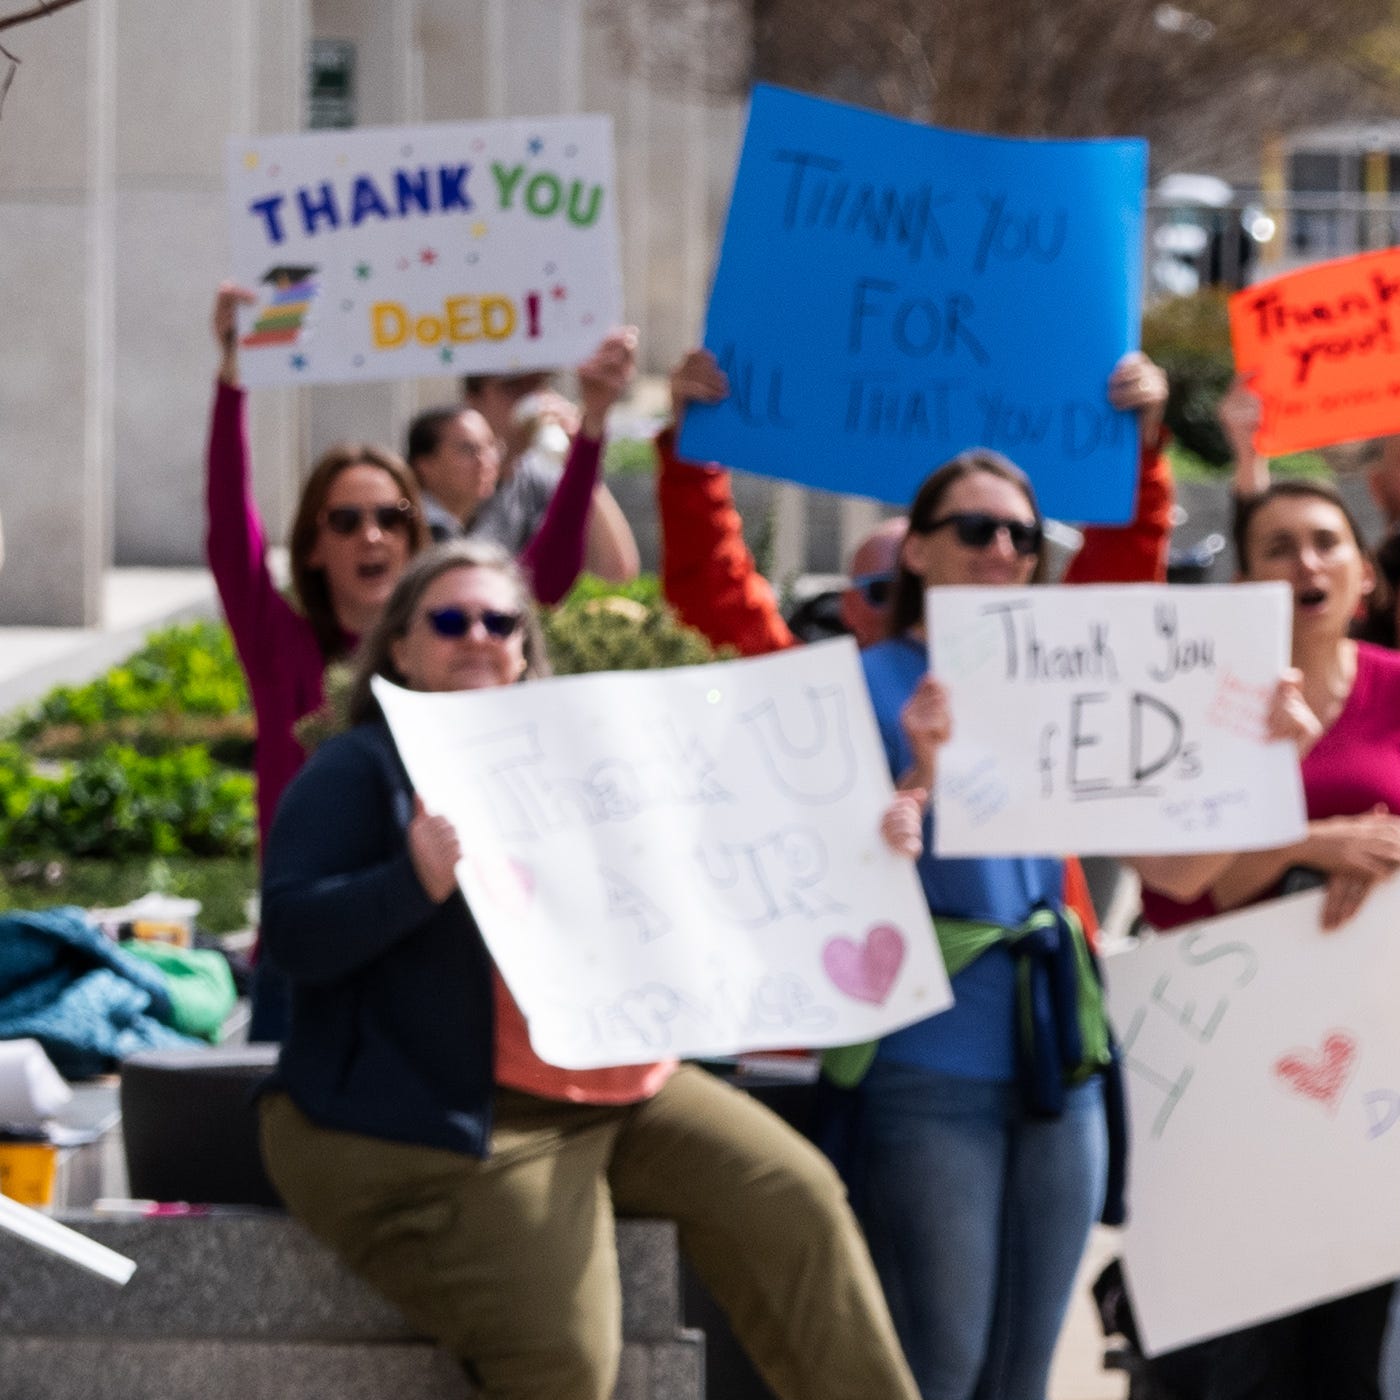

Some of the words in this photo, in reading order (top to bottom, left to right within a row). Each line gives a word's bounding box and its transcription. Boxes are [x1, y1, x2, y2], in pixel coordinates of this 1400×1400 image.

[250, 163, 474, 246] THANK
[489, 159, 605, 229] YOU
[772, 148, 952, 264] THANK
[974, 187, 1070, 275] YOU
[848, 274, 992, 368] FOR
[979, 600, 1120, 683] Thank
[1147, 601, 1216, 683] You
